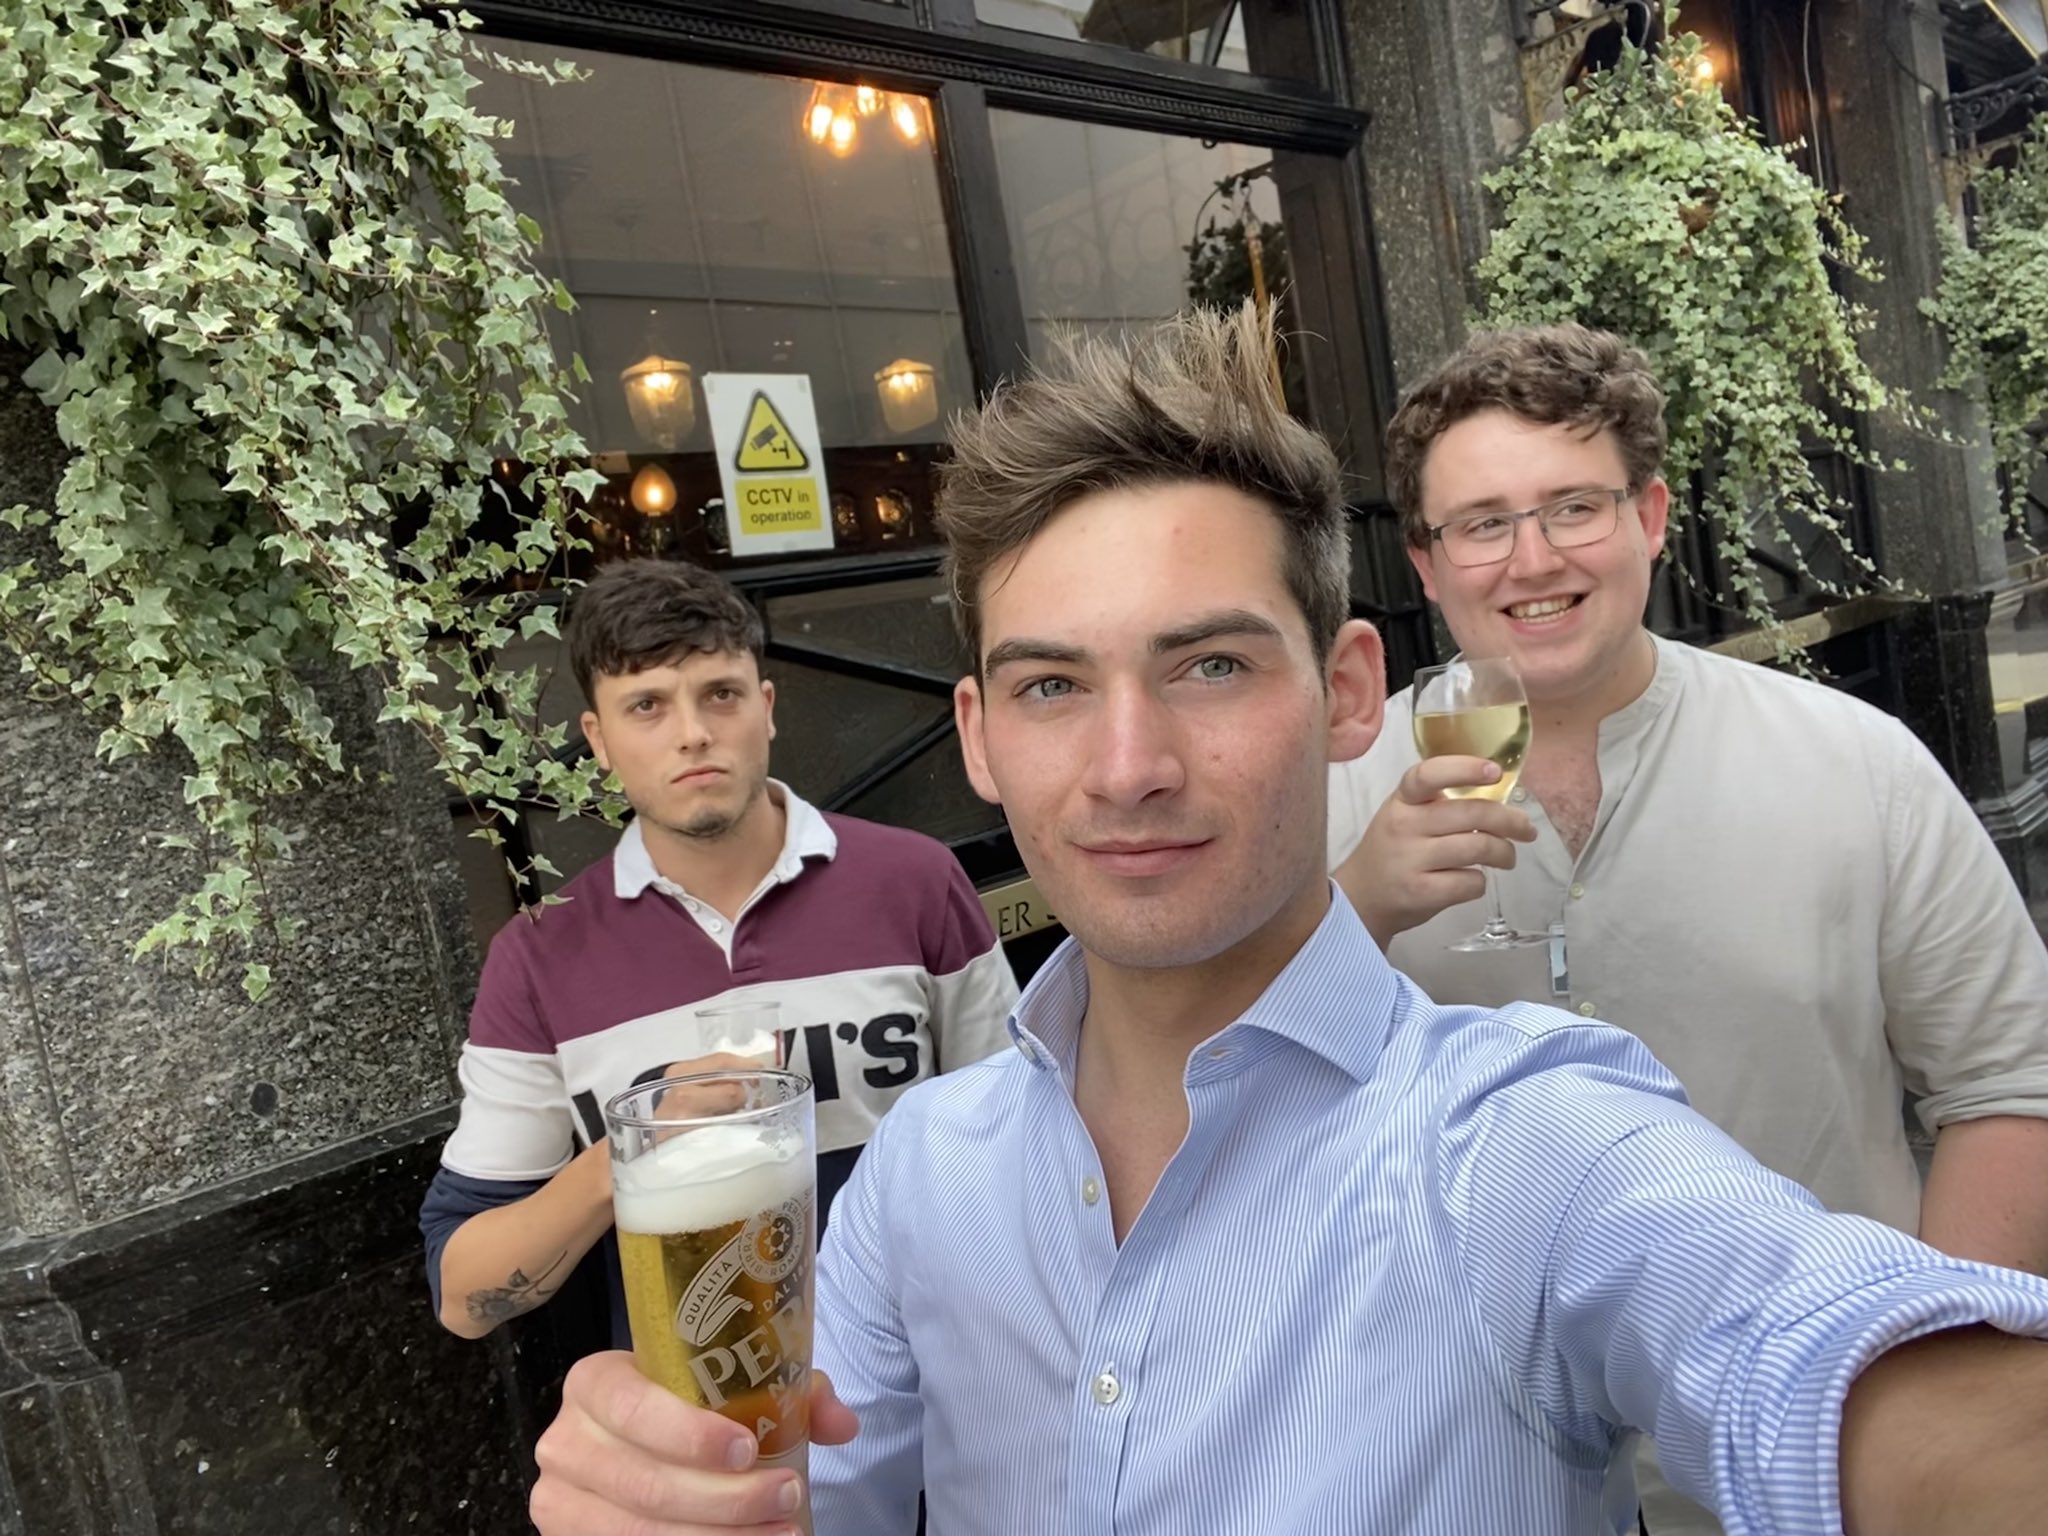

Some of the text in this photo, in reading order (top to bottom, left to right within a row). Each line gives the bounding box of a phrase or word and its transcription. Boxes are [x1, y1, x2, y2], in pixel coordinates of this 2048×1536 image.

[746, 488, 810, 506] CCTV in
[750, 509, 812, 526] operation
